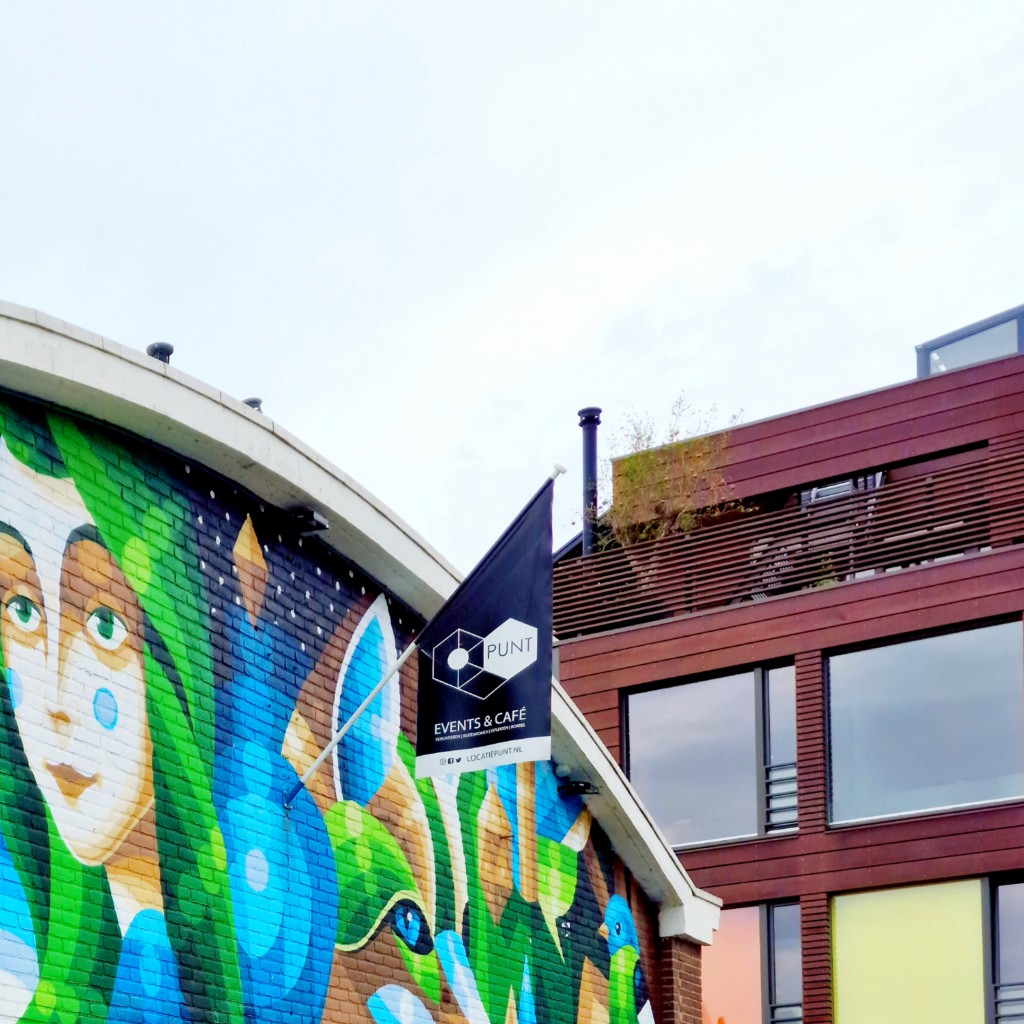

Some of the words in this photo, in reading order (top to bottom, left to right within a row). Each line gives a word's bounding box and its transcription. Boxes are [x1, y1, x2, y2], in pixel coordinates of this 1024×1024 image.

[487, 636, 533, 660] PUNT
[434, 717, 481, 735] EVENTS
[483, 715, 493, 727] &
[494, 706, 527, 725] CAFÉ
[466, 746, 523, 763] LOCATIEPUNT.NL
